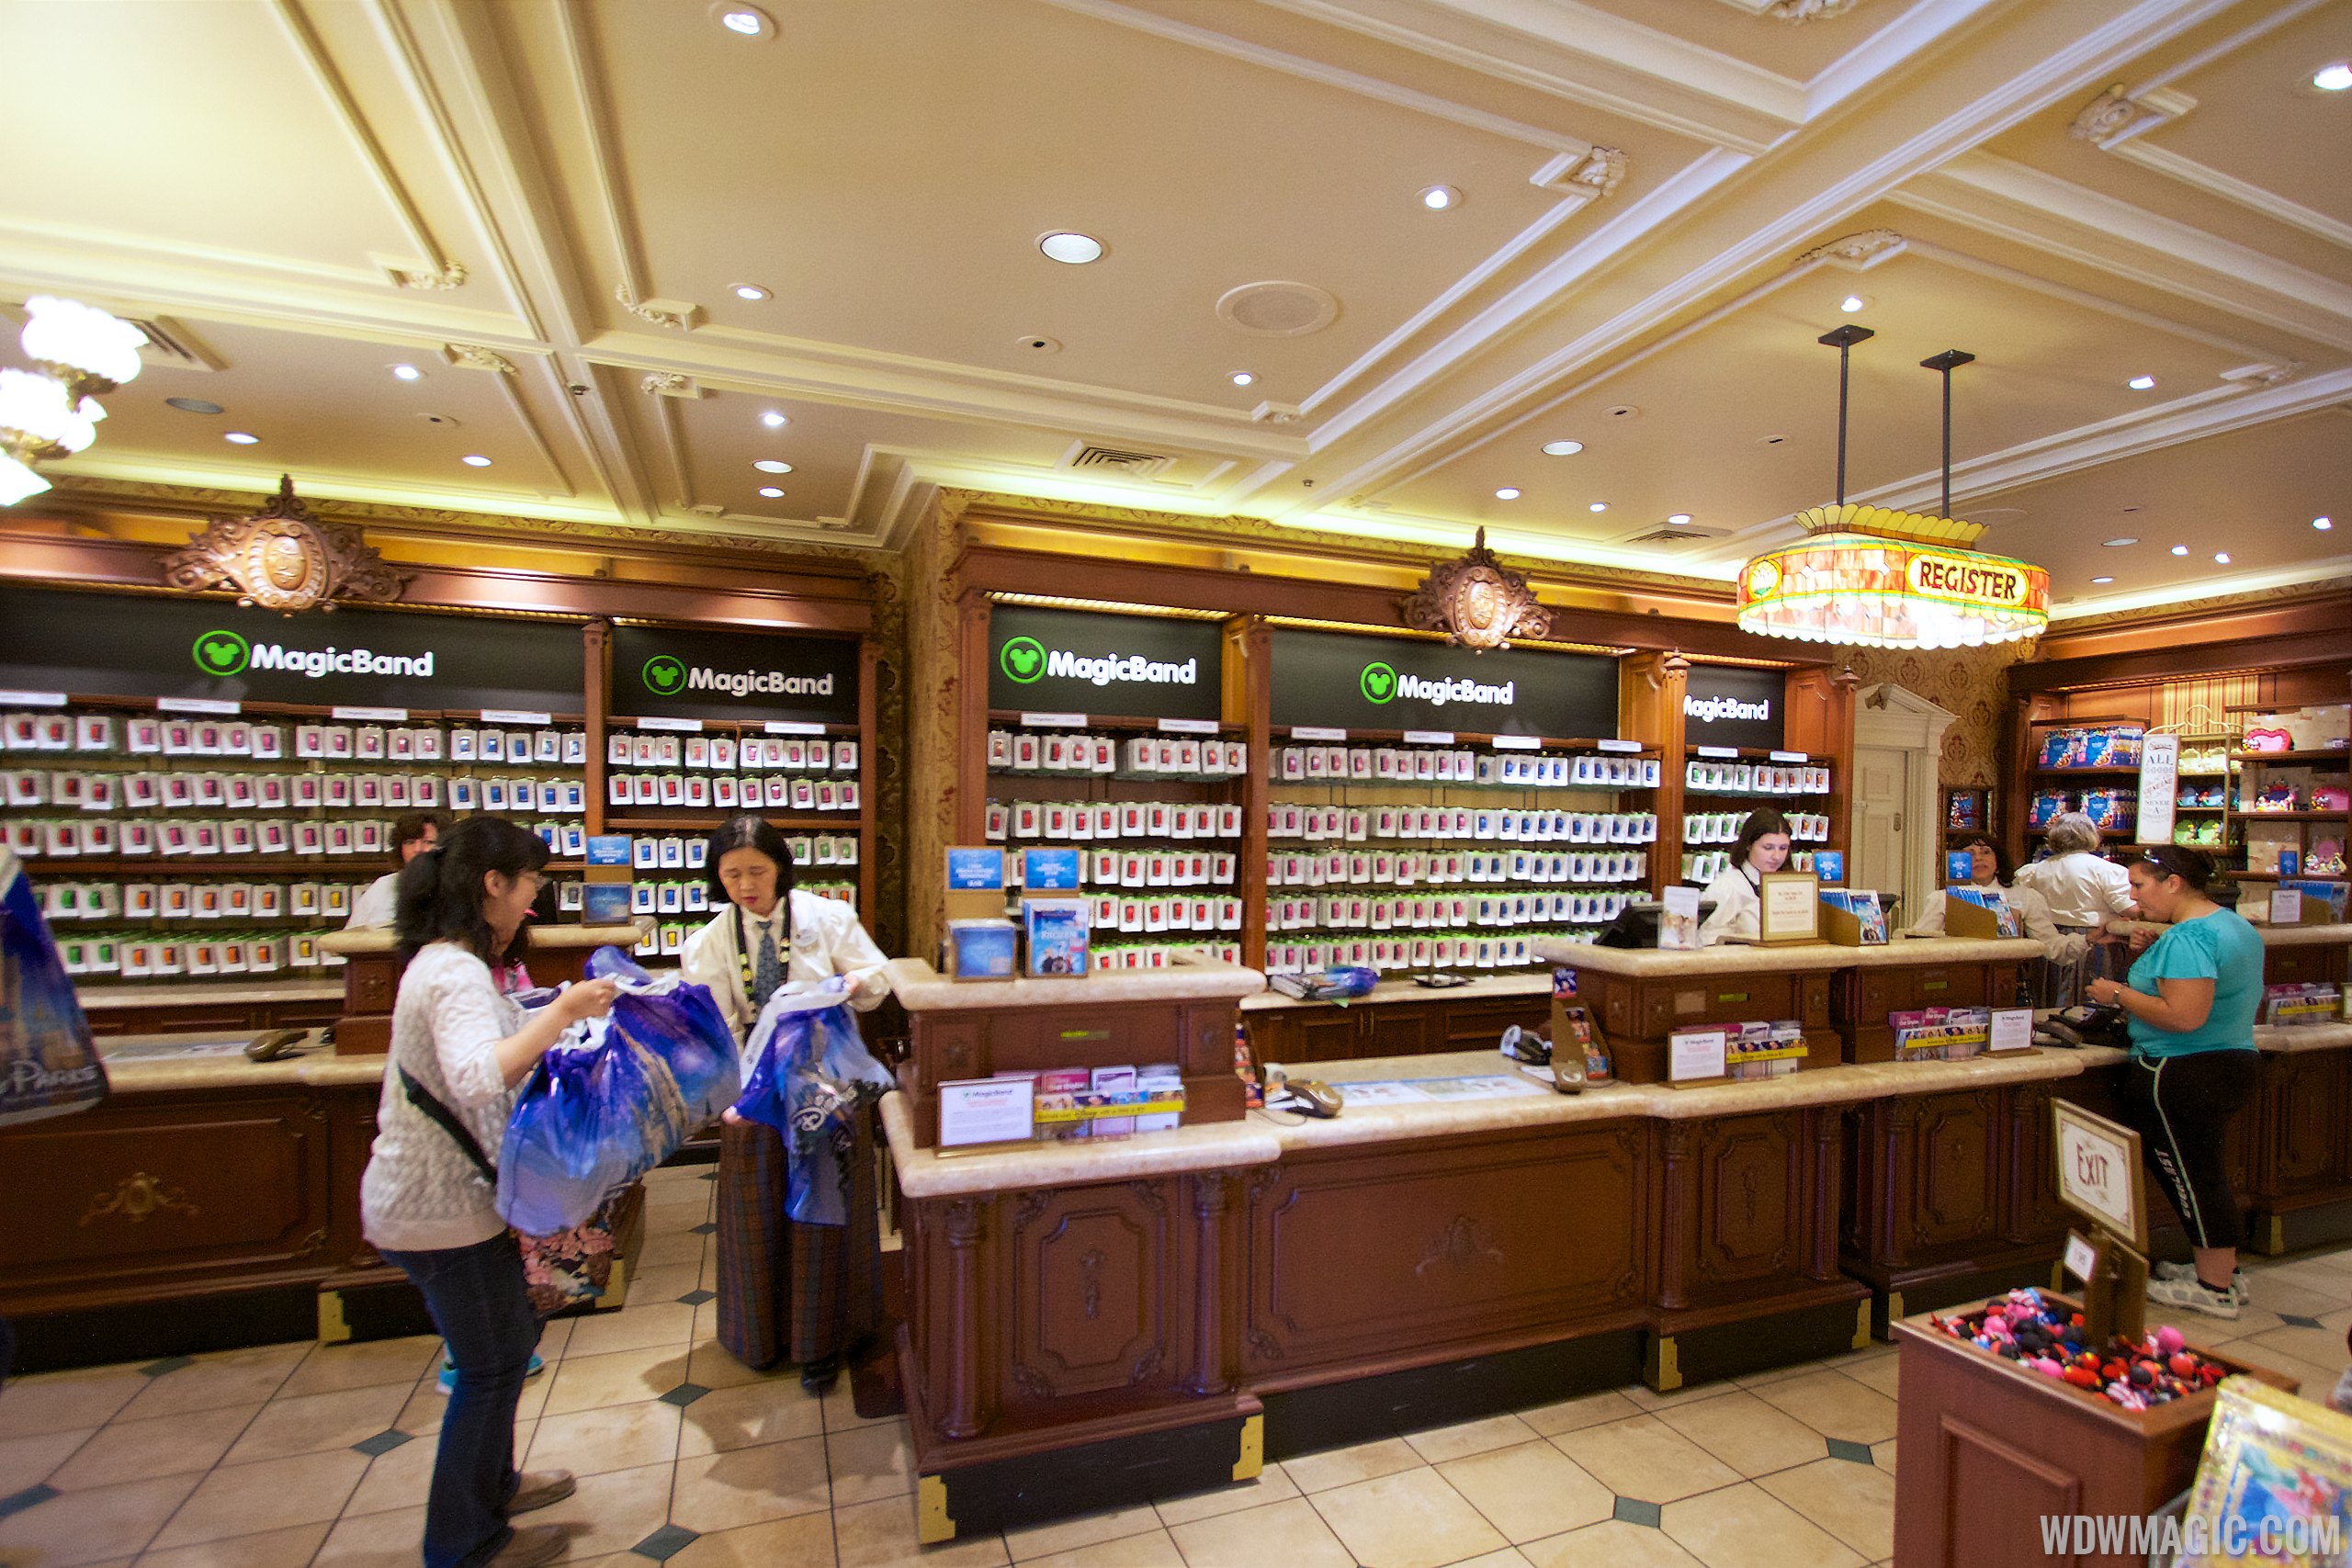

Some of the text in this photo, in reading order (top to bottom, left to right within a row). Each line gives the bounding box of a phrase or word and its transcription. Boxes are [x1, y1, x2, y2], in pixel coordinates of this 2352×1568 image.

[1919, 560, 2017, 600] REGISTER
[250, 643, 434, 678] MagicBand
[1046, 649, 1196, 686] MagicBand
[687, 667, 832, 697] MagicBand
[1396, 674, 1514, 706] MagicBand
[2143, 766, 2175, 774] GOODS
[2145, 753, 2174, 766] ALL
[2076, 1142, 2109, 1189] EXIT
